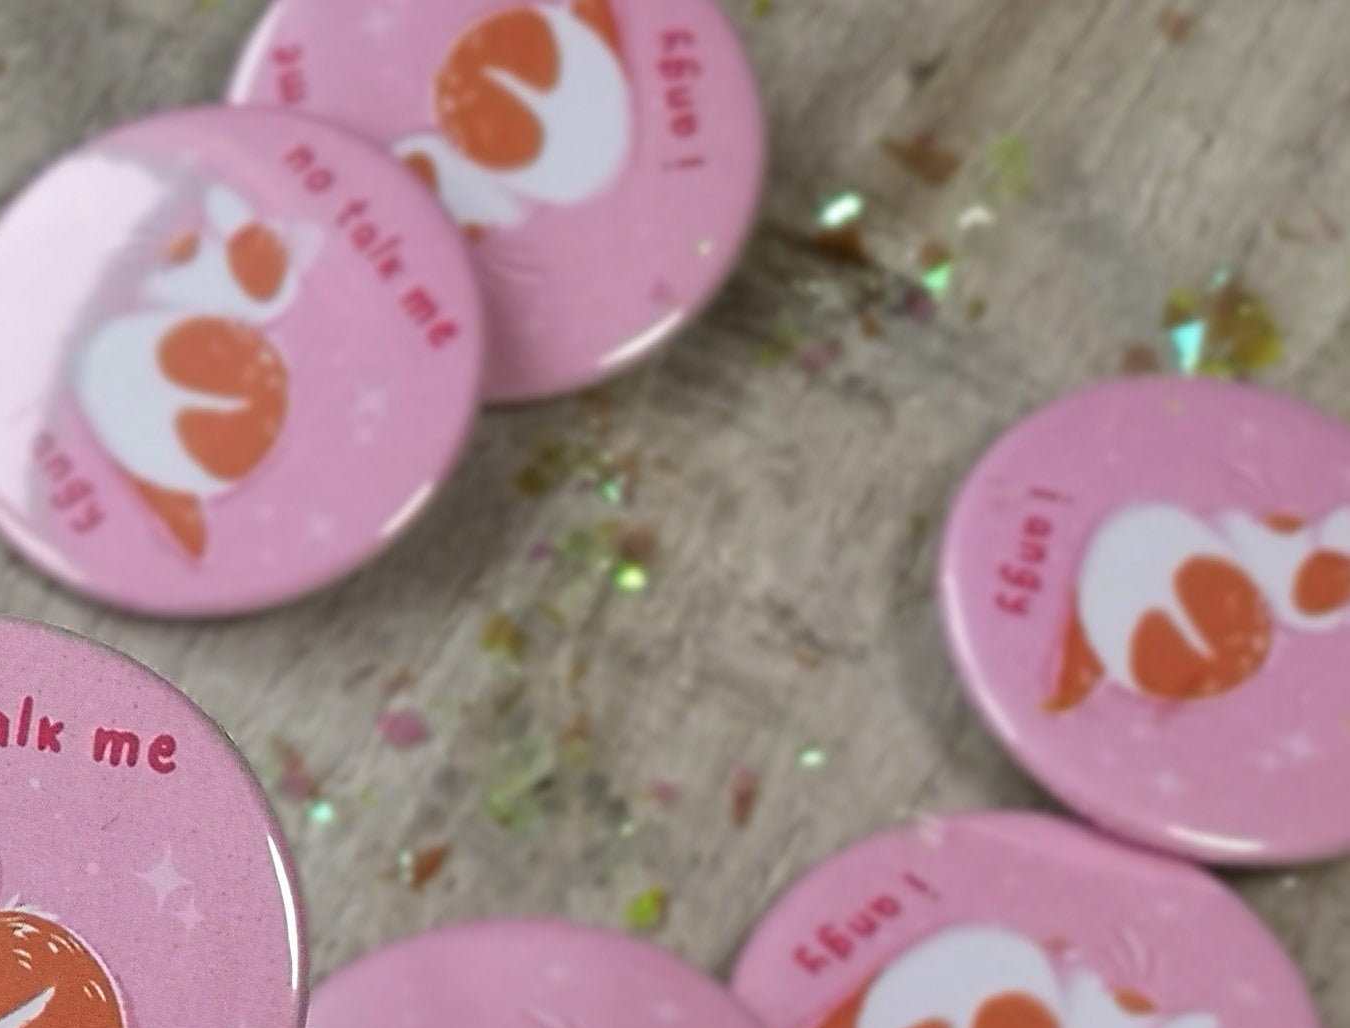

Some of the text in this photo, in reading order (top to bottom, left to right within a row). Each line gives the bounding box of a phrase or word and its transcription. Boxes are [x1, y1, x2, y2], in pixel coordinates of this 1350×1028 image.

[271, 43, 307, 106] me
[657, 30, 707, 149] angy
[282, 143, 459, 349] no talk me
[994, 516, 1054, 617] angy
[92, 724, 177, 773] me
[792, 895, 902, 975] angy
